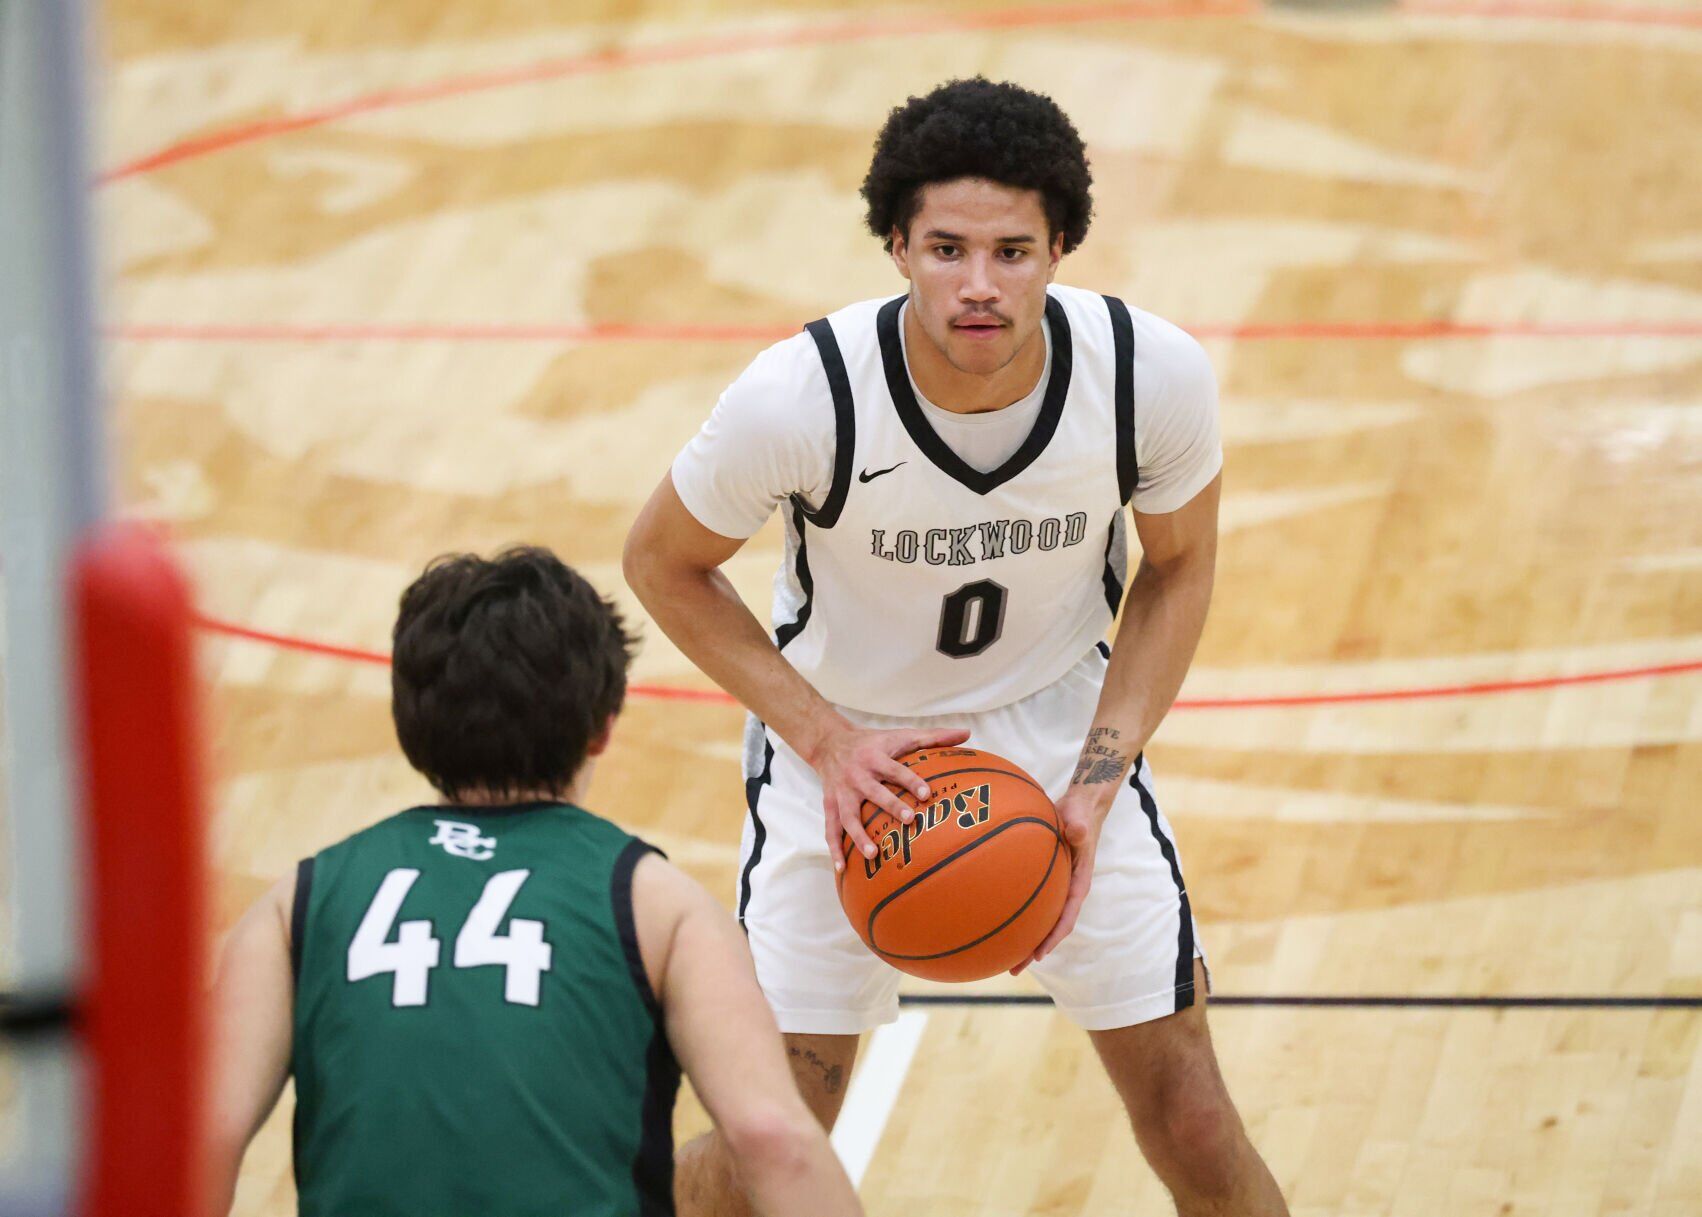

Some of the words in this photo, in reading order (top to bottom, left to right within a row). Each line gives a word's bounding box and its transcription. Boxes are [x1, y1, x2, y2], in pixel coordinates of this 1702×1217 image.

[871, 511, 1088, 566] LOCKWOOD
[936, 578, 1009, 660] 0
[347, 868, 552, 1007] 44
